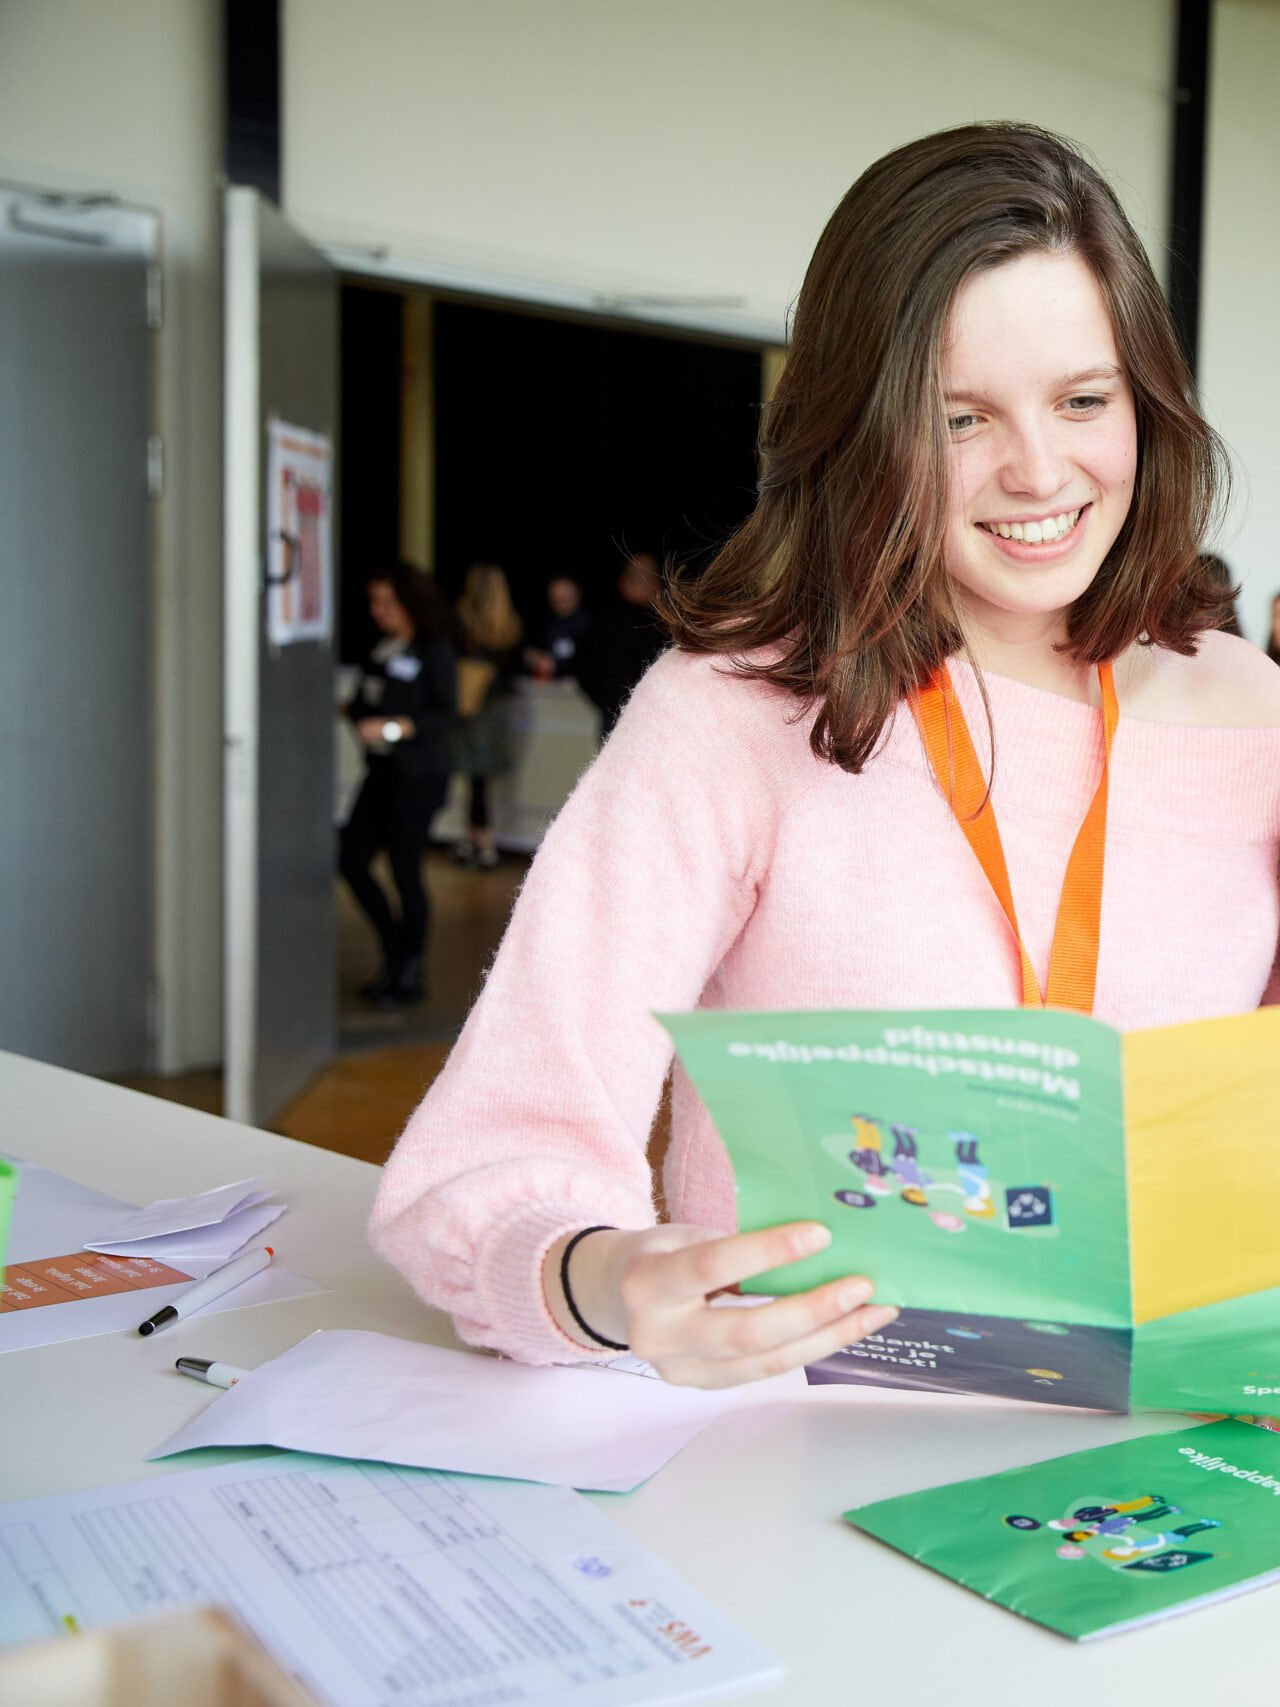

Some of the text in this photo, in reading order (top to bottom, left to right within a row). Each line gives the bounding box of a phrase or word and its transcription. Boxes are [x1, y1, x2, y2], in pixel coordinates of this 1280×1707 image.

[883, 1025, 1080, 1070] diensttijd
[727, 1041, 1081, 1099] Maatschappelijke
[850, 1341, 937, 1360] oor je
[864, 1334, 956, 1354] dankt
